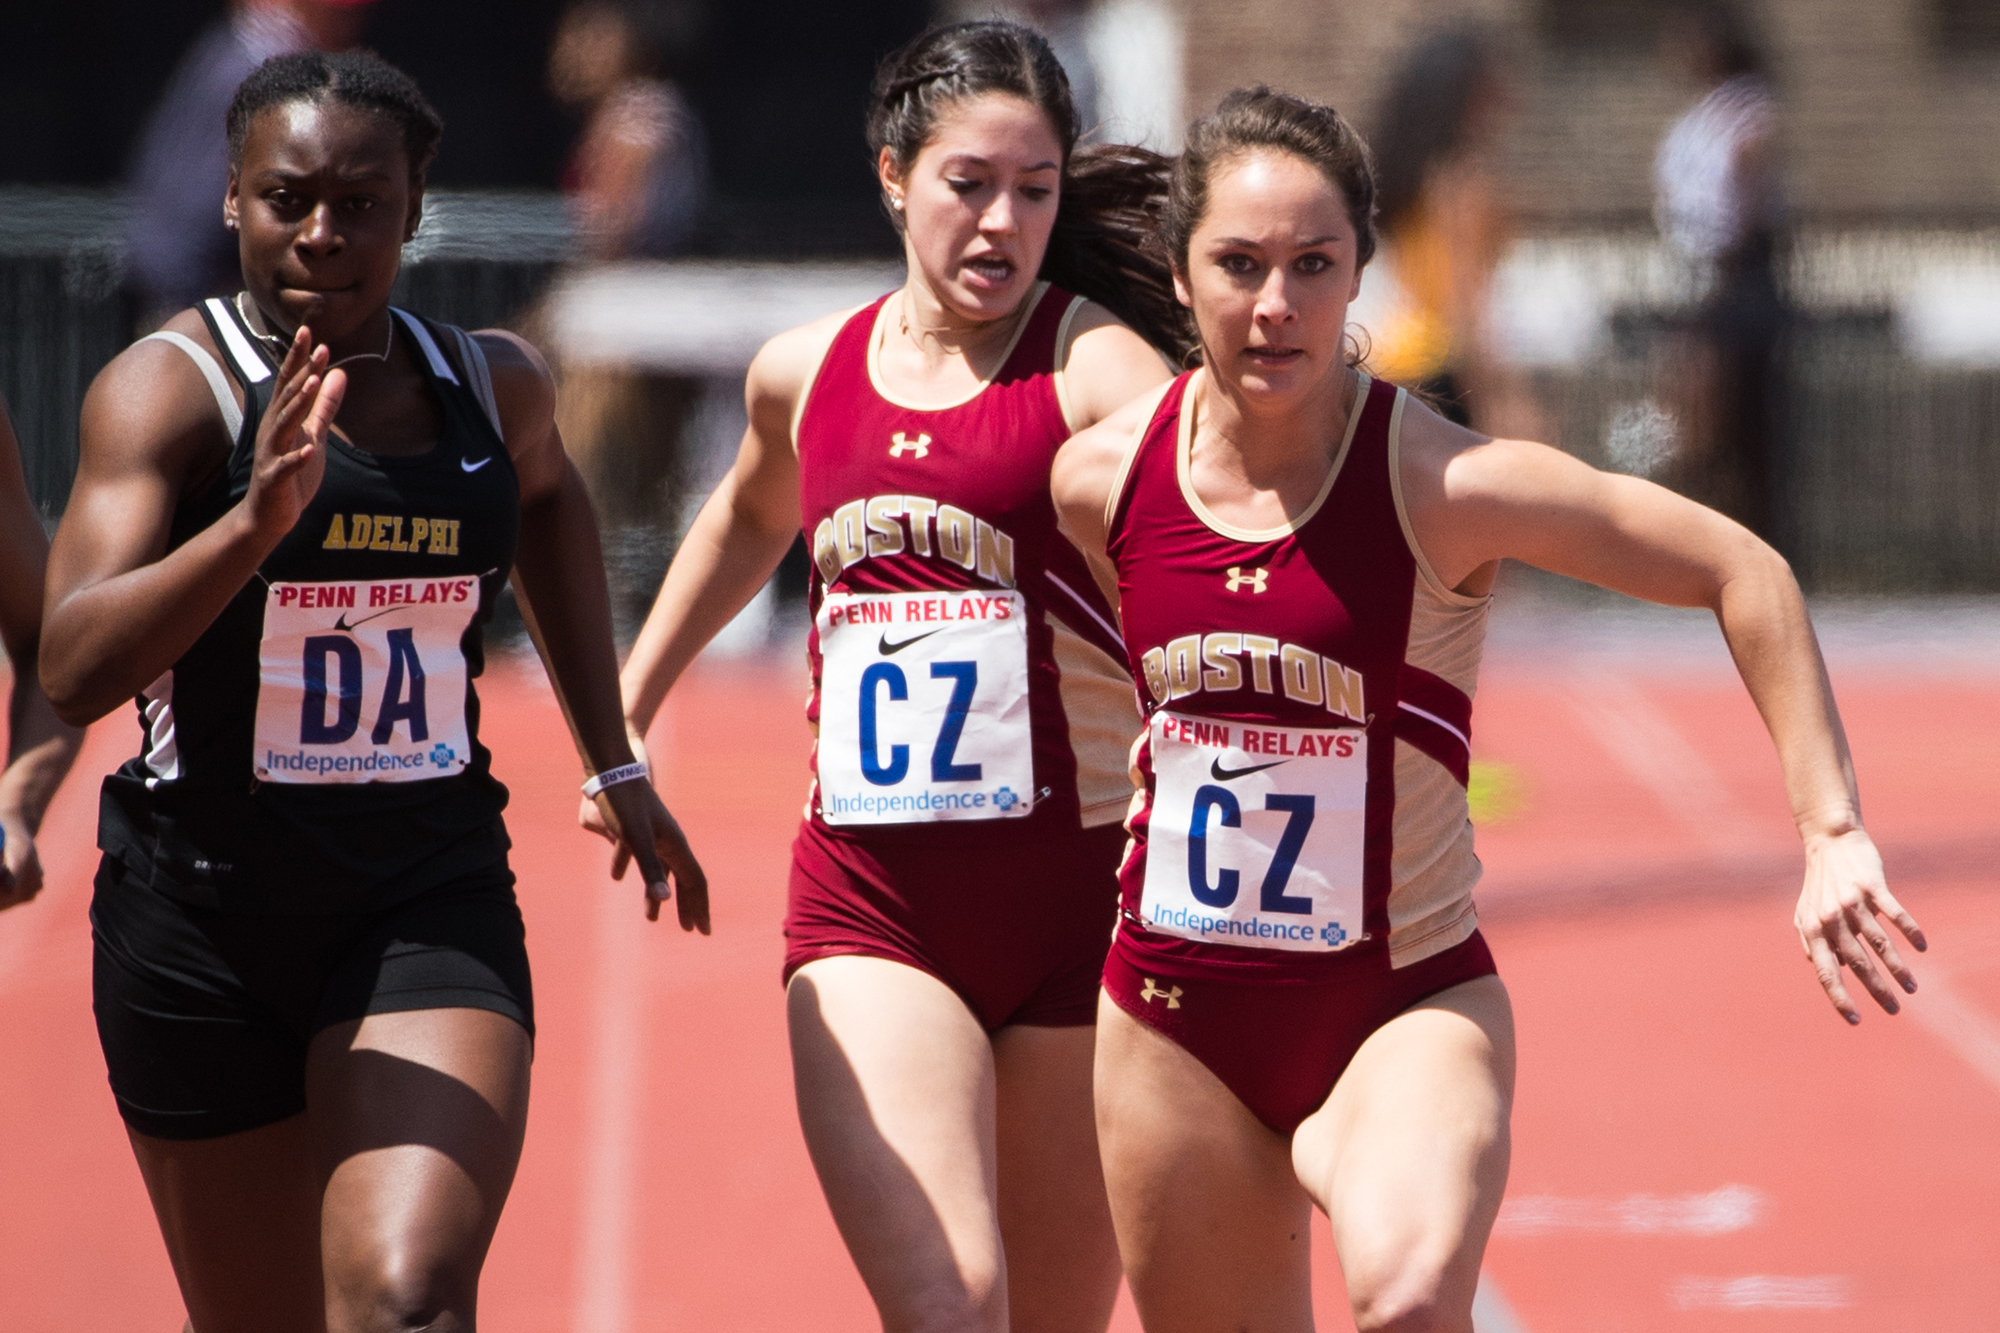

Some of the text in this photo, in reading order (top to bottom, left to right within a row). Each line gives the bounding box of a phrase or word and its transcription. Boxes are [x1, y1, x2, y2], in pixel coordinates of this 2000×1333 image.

[322, 513, 461, 555] ADELPHI
[814, 495, 1015, 589] BOSTON
[279, 580, 469, 609] PENN RELAYS
[829, 596, 1011, 627] PENN RELAYS
[299, 627, 429, 745] DA
[1141, 632, 1366, 724] BOSTON
[858, 660, 983, 786] CZ
[1162, 717, 1354, 758] PENN RELAYS
[266, 749, 425, 776] Independence
[831, 790, 987, 815] Independence
[1187, 784, 1315, 914] CZ
[1153, 903, 1314, 941] Independence
